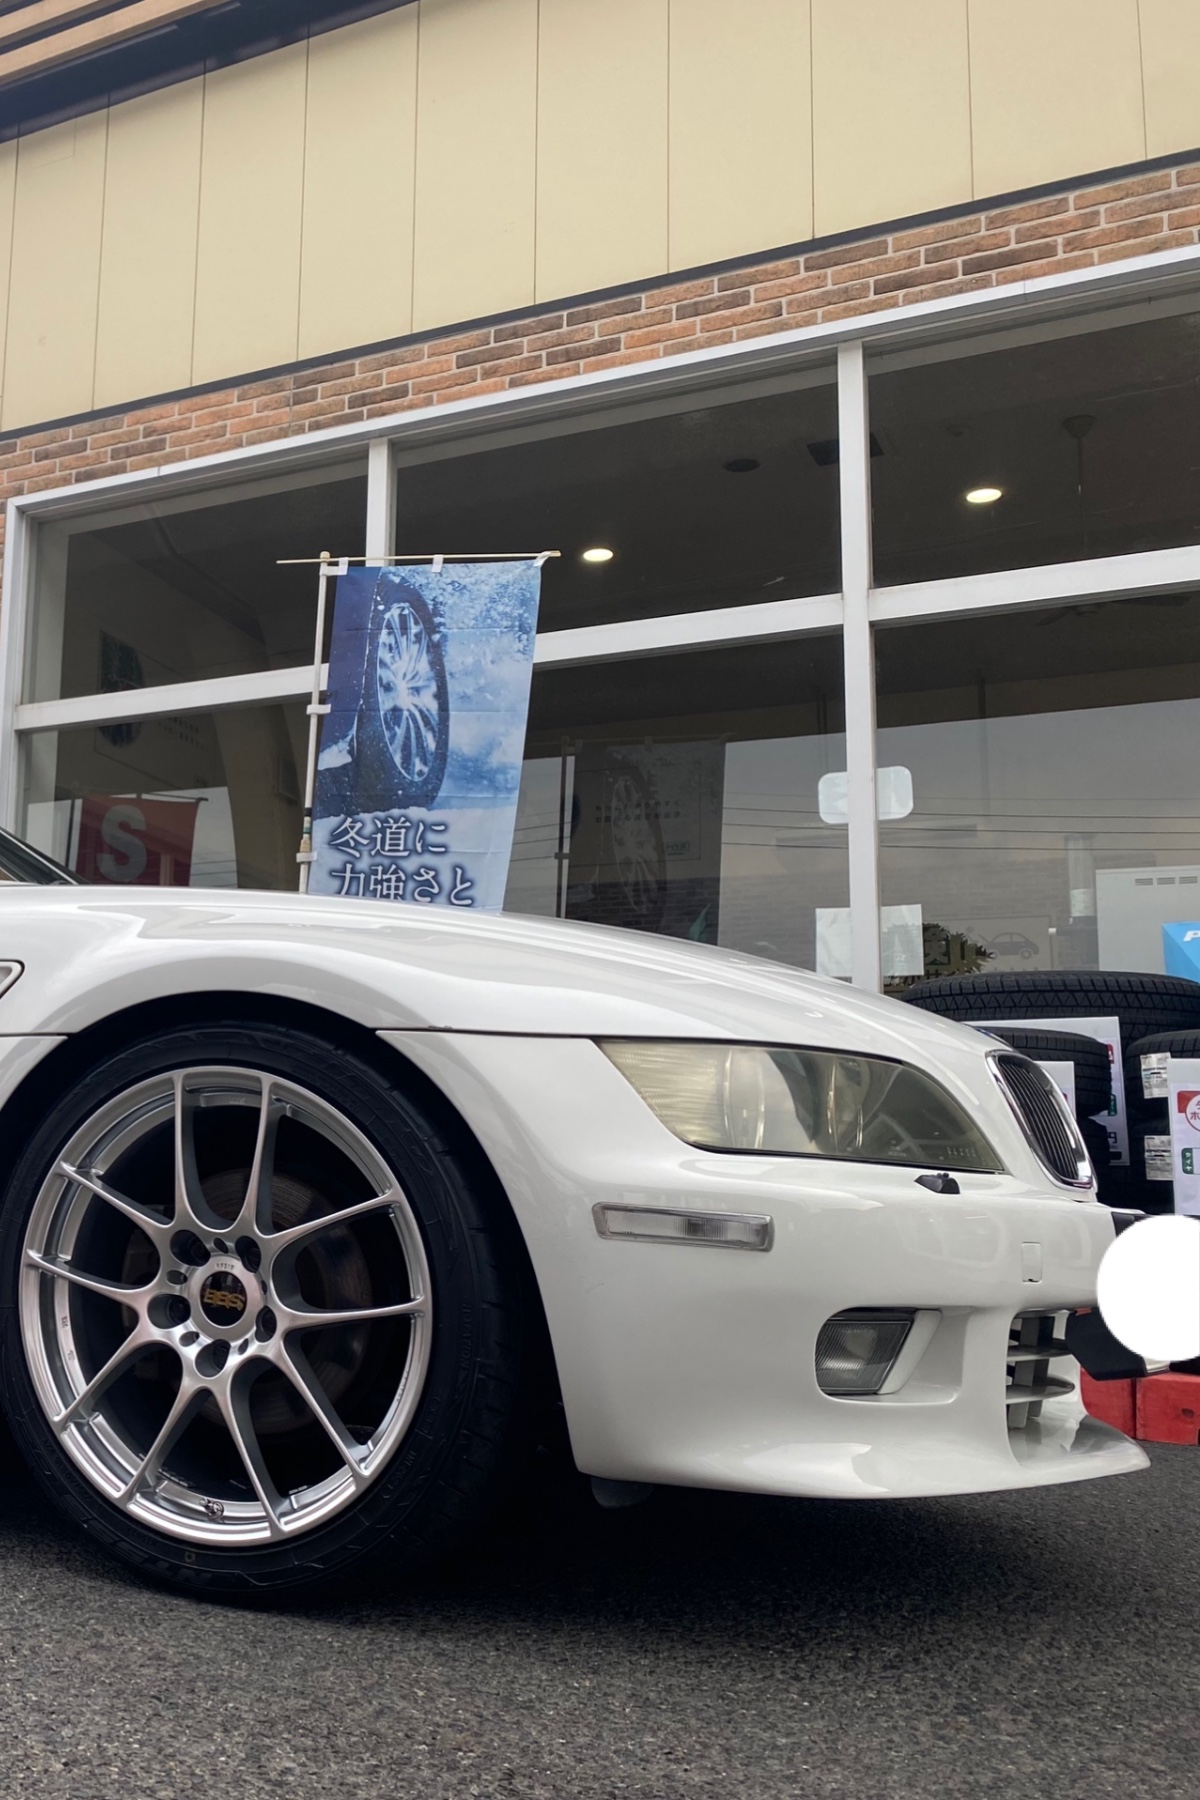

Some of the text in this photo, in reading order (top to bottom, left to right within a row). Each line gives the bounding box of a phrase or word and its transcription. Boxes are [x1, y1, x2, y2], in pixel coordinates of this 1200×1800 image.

[96, 804, 148, 883] S
[330, 816, 448, 858] 冬道に
[331, 863, 476, 907] 力強さと
